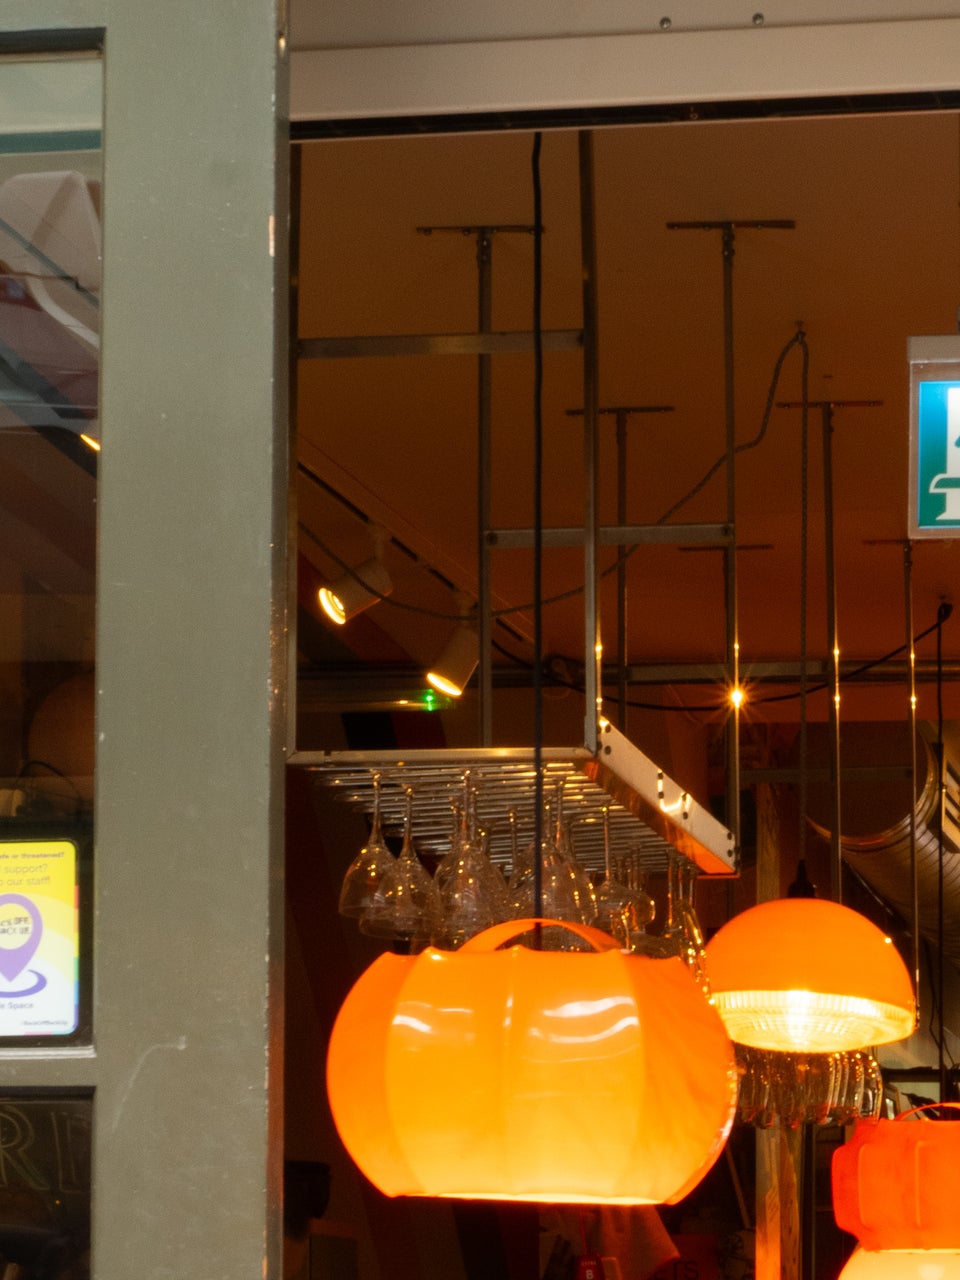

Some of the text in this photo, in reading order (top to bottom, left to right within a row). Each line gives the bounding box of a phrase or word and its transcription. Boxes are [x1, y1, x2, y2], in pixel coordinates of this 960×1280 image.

[4, 863, 48, 875] support?
[7, 1001, 34, 1010] Space
[653, 1260, 699, 1280] ETS
